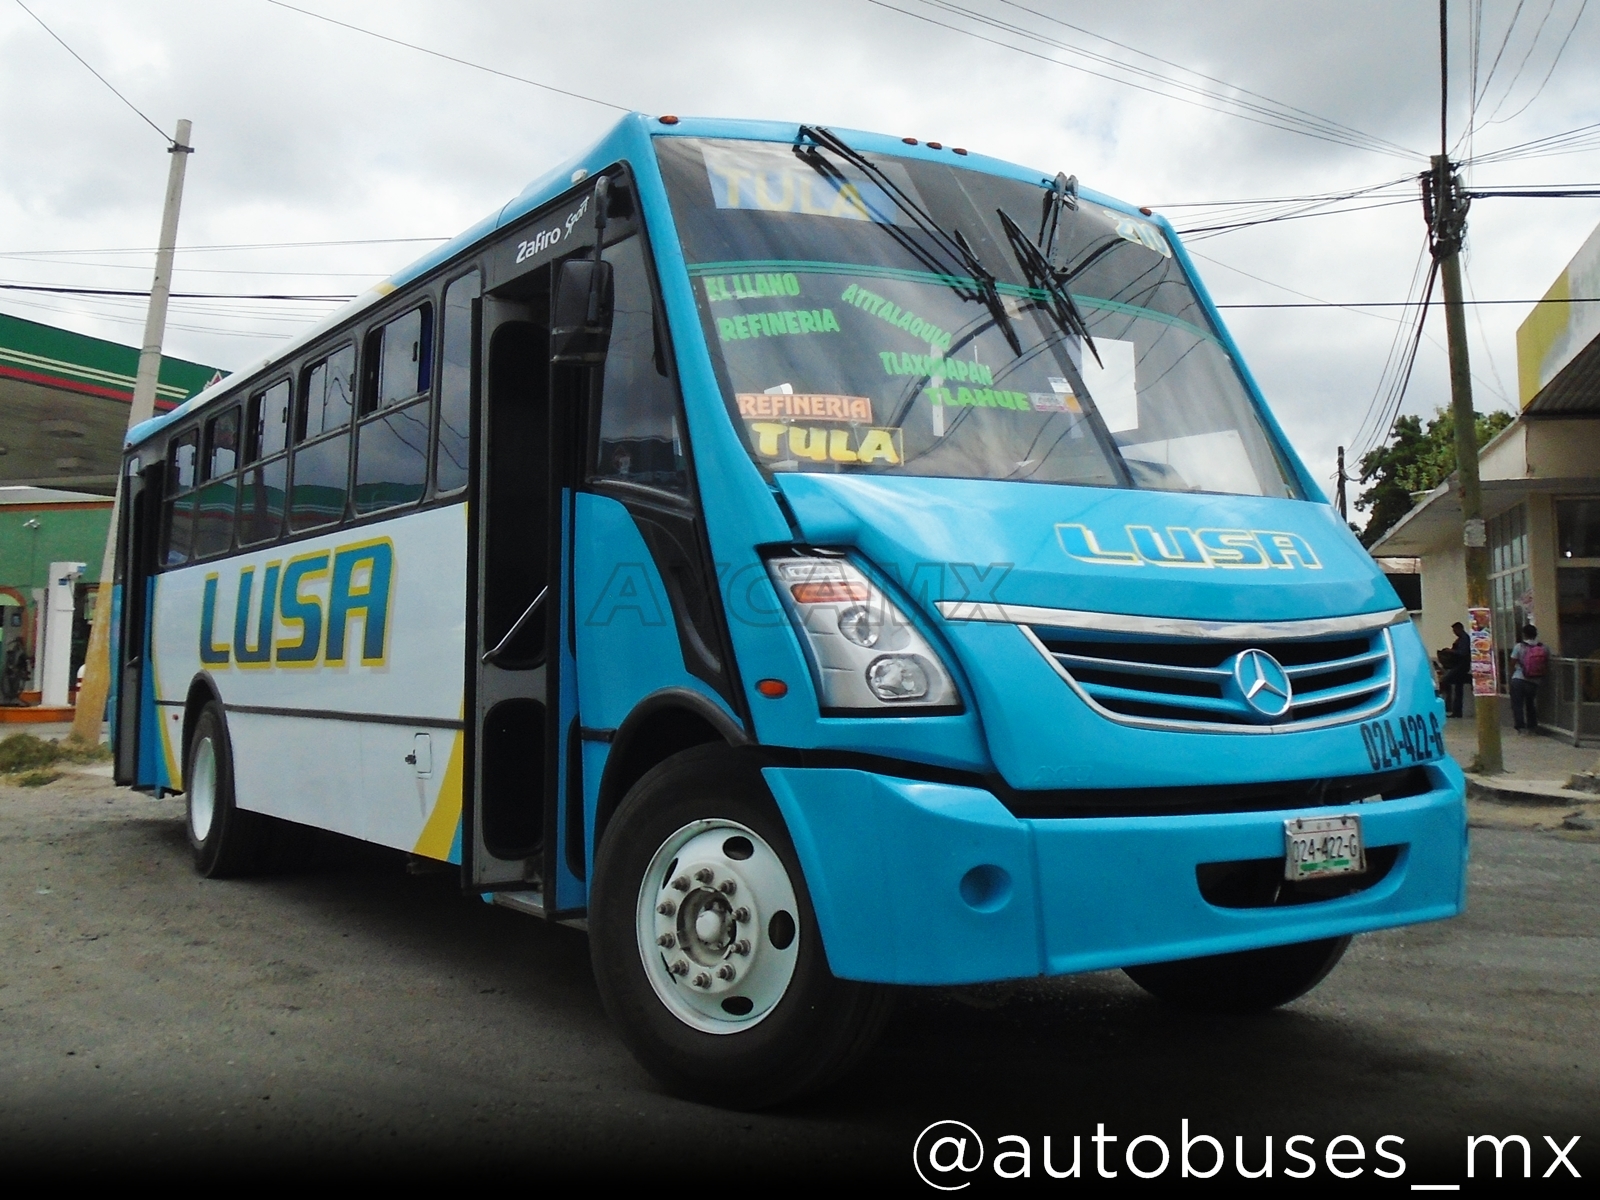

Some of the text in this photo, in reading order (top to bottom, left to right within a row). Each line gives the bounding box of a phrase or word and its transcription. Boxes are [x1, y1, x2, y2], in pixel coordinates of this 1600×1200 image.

[711, 164, 873, 222] TULA
[704, 272, 801, 301] EL LLANO
[717, 308, 841, 342] REFINERIA
[739, 395, 868, 419] REFINERIA
[751, 422, 900, 464] TULA
[1054, 523, 1324, 570] LUSA
[199, 535, 395, 671] LUSA
[1360, 711, 1445, 771] 024-422-G
[1292, 833, 1358, 864] 024-422-G
